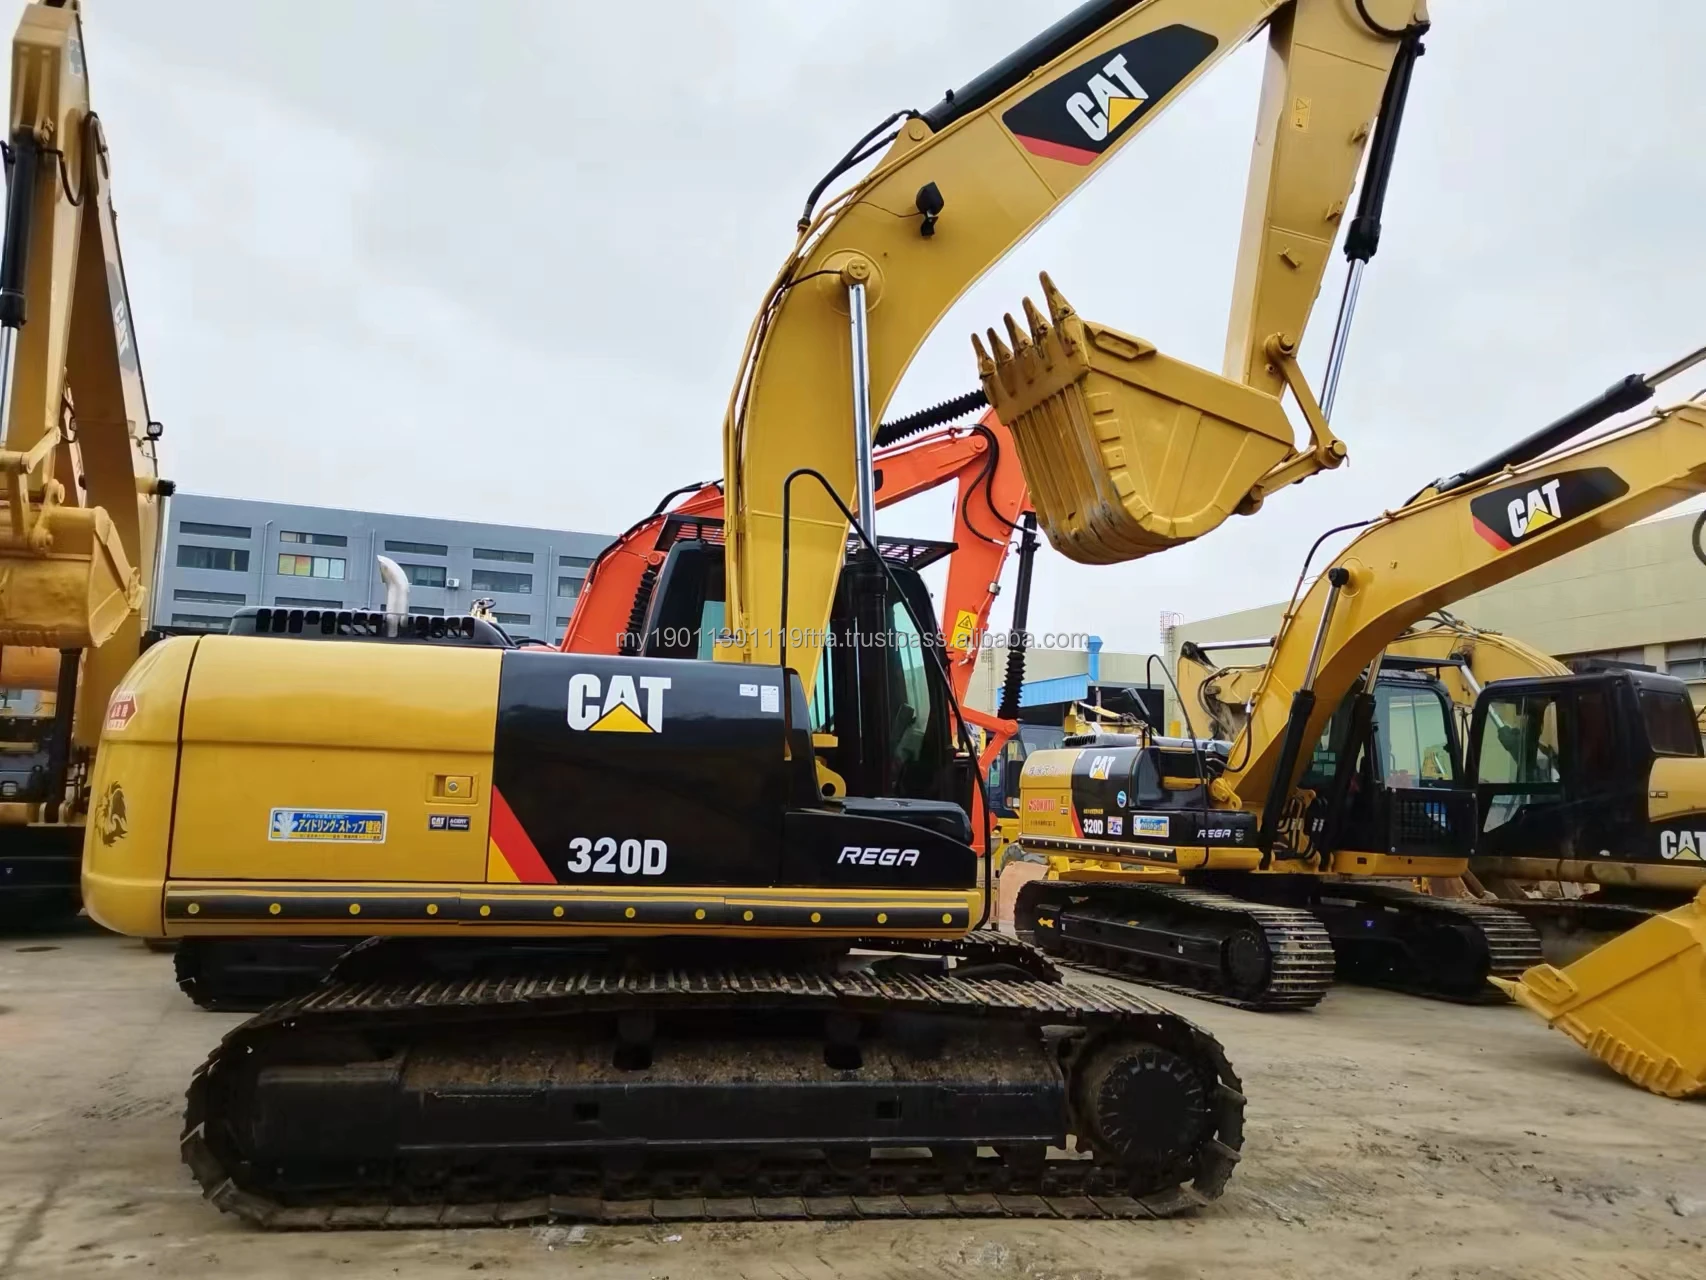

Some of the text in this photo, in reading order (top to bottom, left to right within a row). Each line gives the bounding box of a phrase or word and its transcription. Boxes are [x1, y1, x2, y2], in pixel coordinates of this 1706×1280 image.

[1066, 53, 1149, 141] CAT
[1507, 478, 1562, 538] CAT
[567, 673, 672, 733] CAT
[1089, 755, 1116, 780] CAT
[1083, 818, 1104, 835] 320D
[1197, 829, 1232, 838] REGA
[567, 837, 668, 875] 320D
[837, 846, 920, 867] REGA
[1660, 830, 1706, 860] CAT
